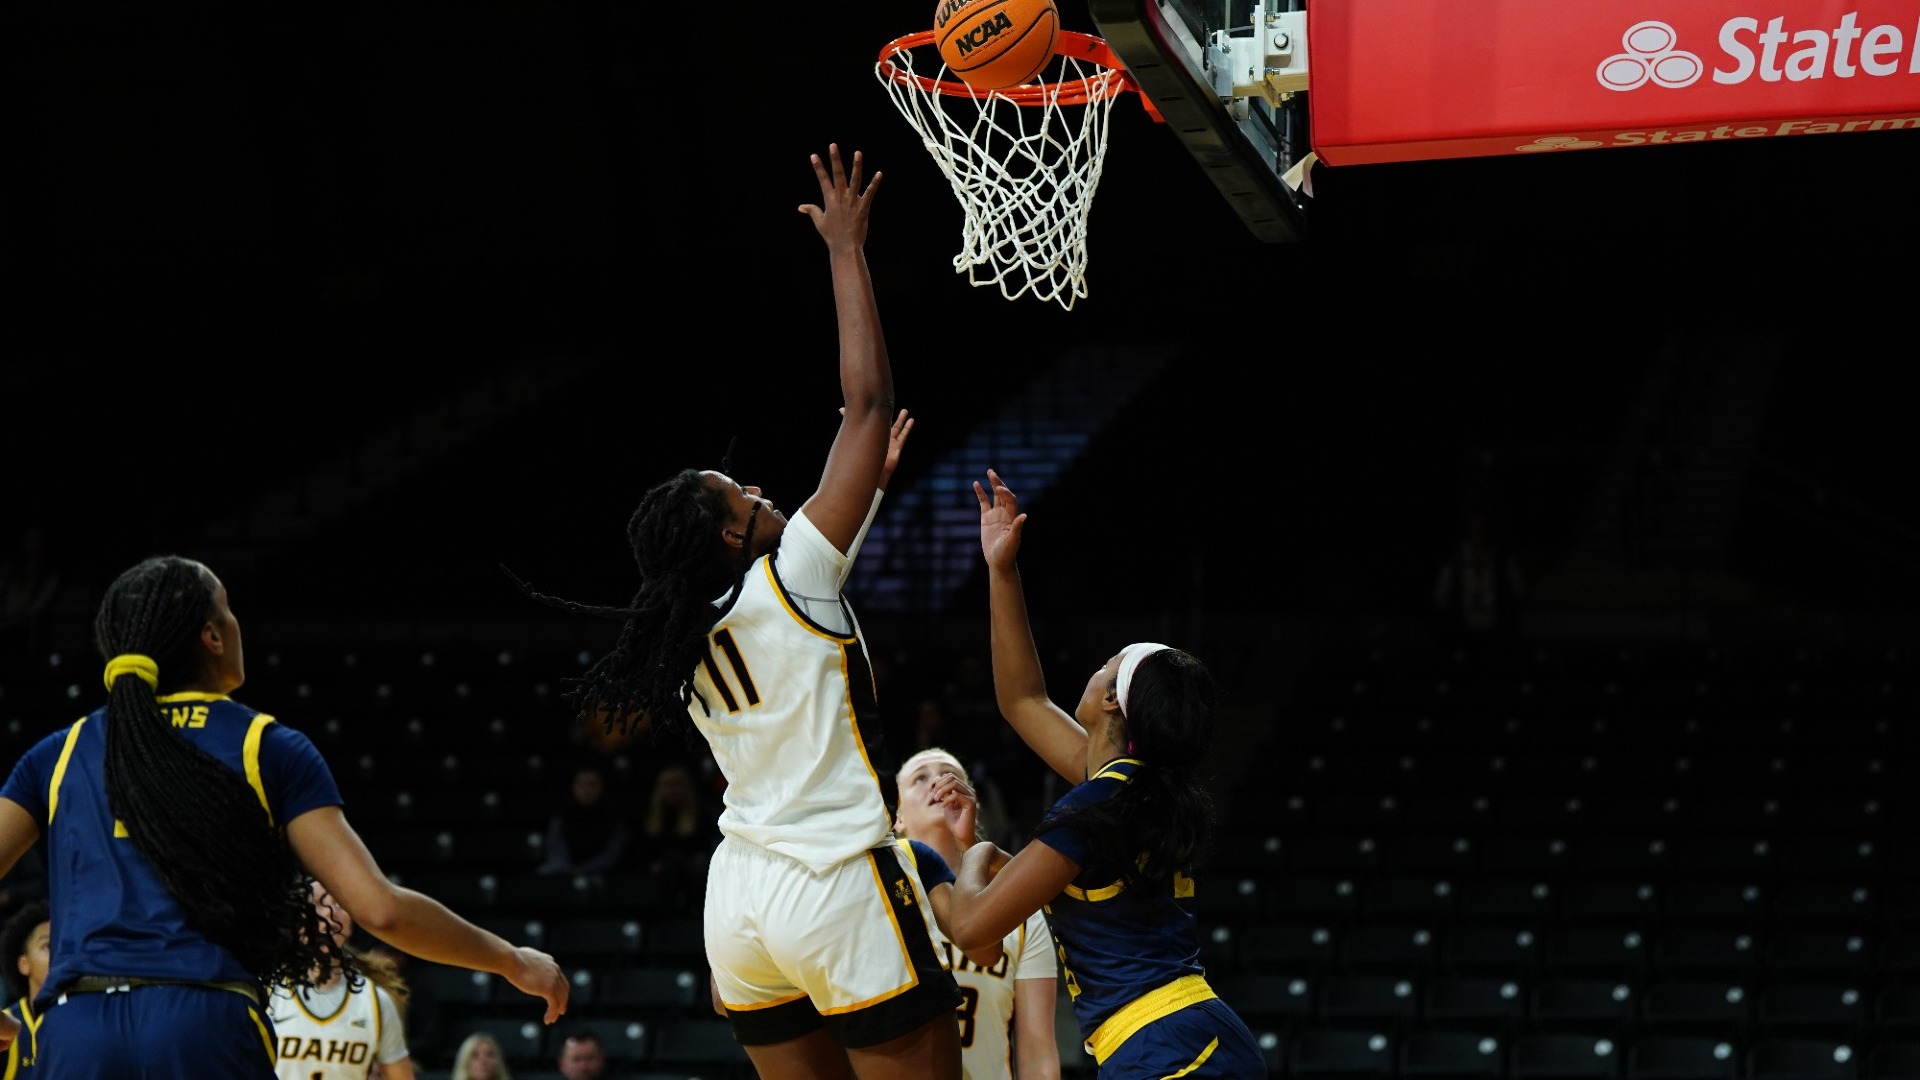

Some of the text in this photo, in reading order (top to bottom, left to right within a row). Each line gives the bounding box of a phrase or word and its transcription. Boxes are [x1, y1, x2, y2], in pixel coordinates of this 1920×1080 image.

[955, 10, 1013, 57] NCAA
[1712, 11, 1903, 85] State
[1612, 115, 1920, 147] State Farm
[161, 705, 209, 728] NS
[279, 1035, 369, 1066] DAHO
